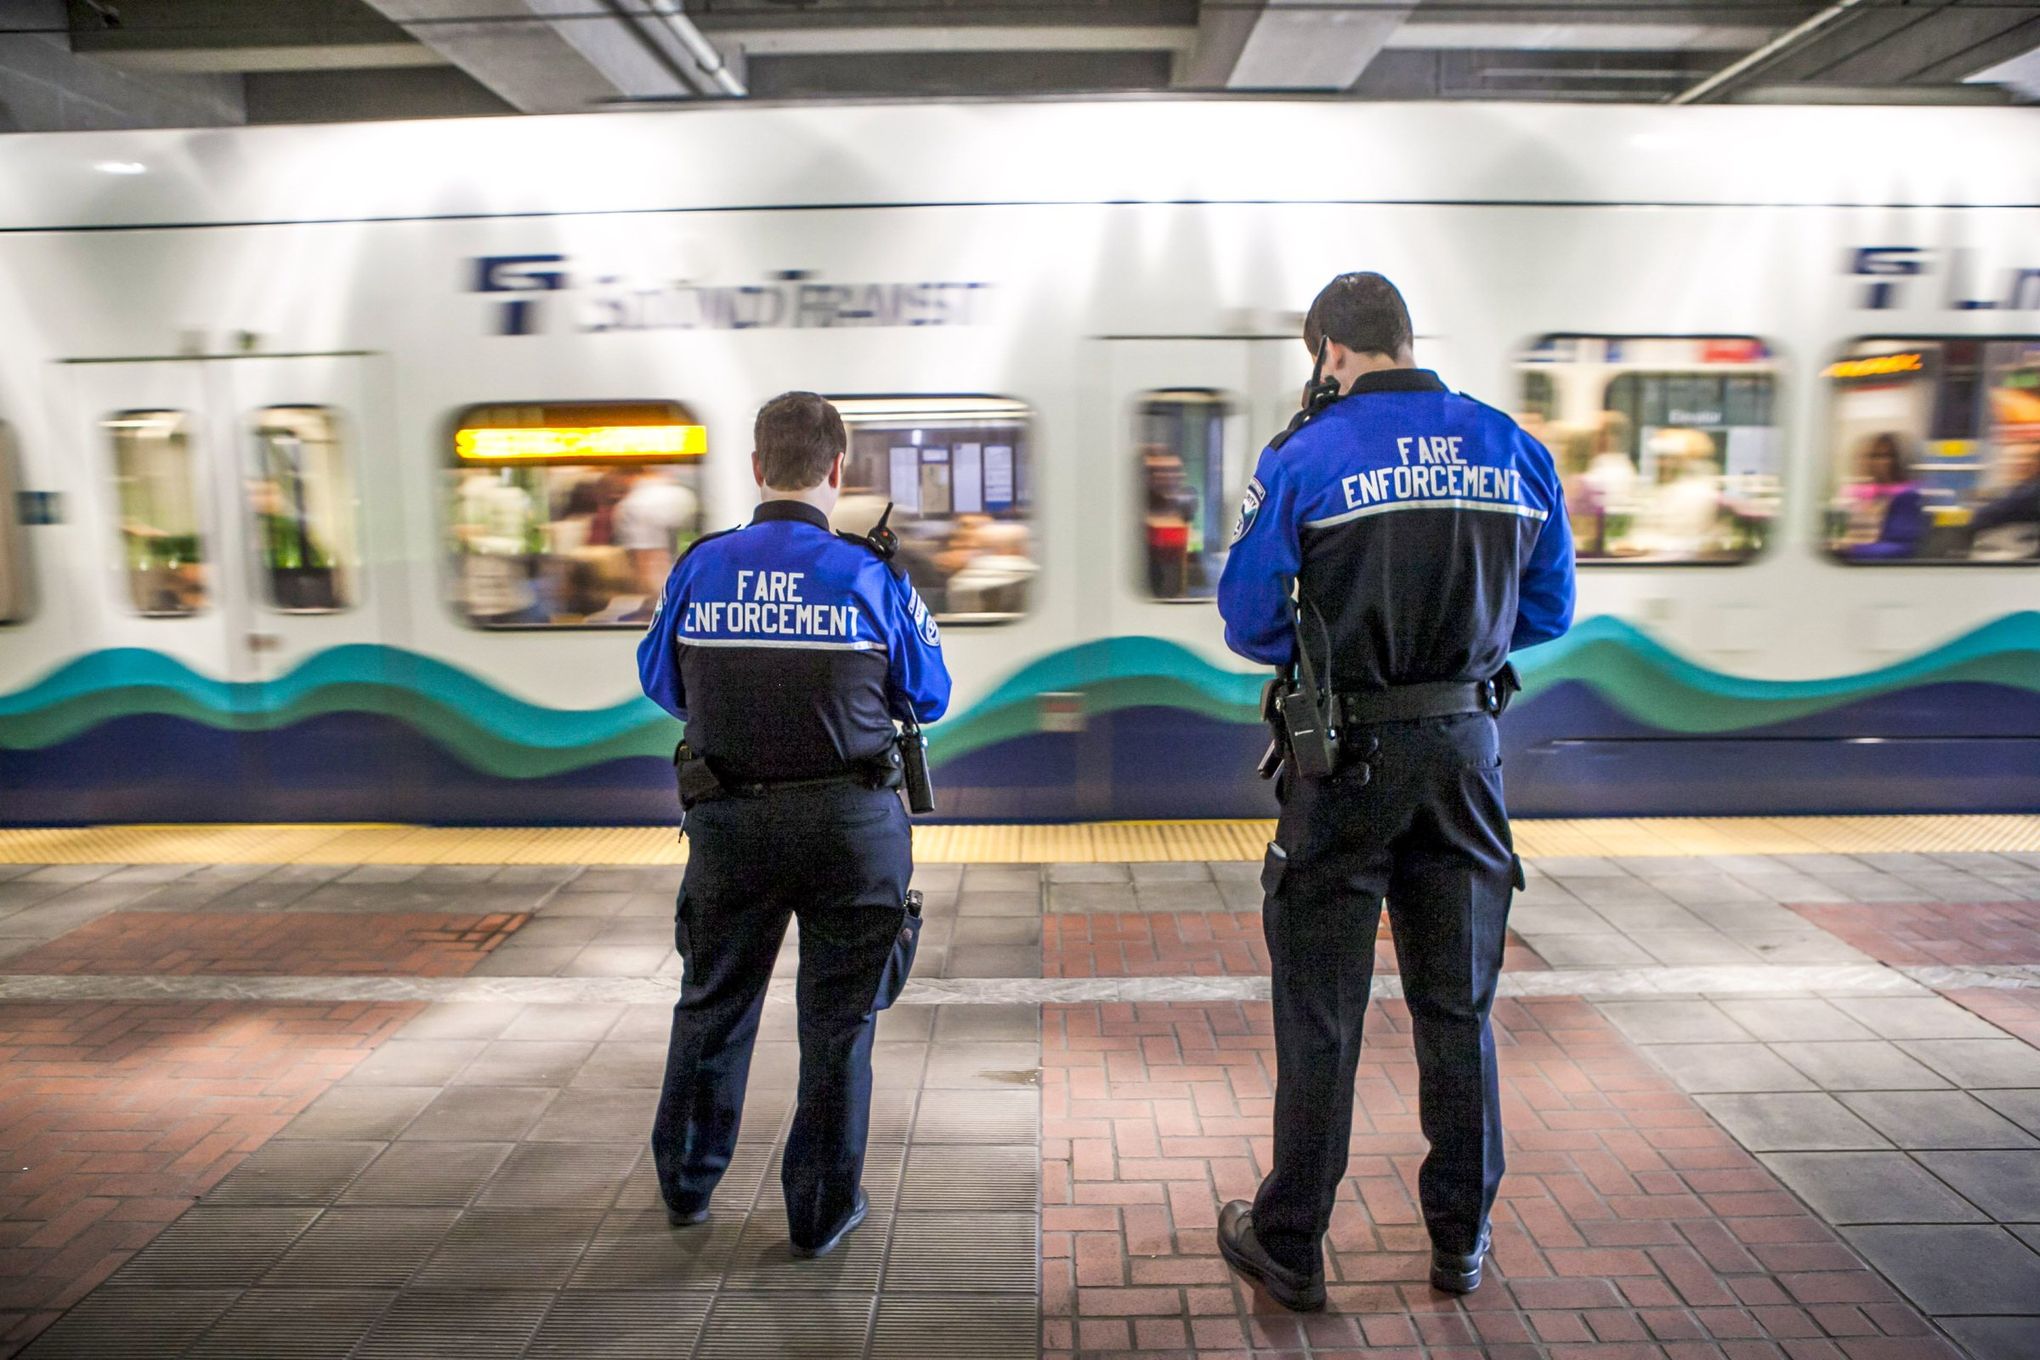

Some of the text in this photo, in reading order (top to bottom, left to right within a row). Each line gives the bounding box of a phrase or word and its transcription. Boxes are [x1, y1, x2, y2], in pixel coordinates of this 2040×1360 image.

[1397, 436, 1467, 465] FARE
[1342, 465, 1521, 509] ENFORCEMENT
[737, 570, 804, 602] FARE
[685, 602, 859, 636] ENFORCEMENT
